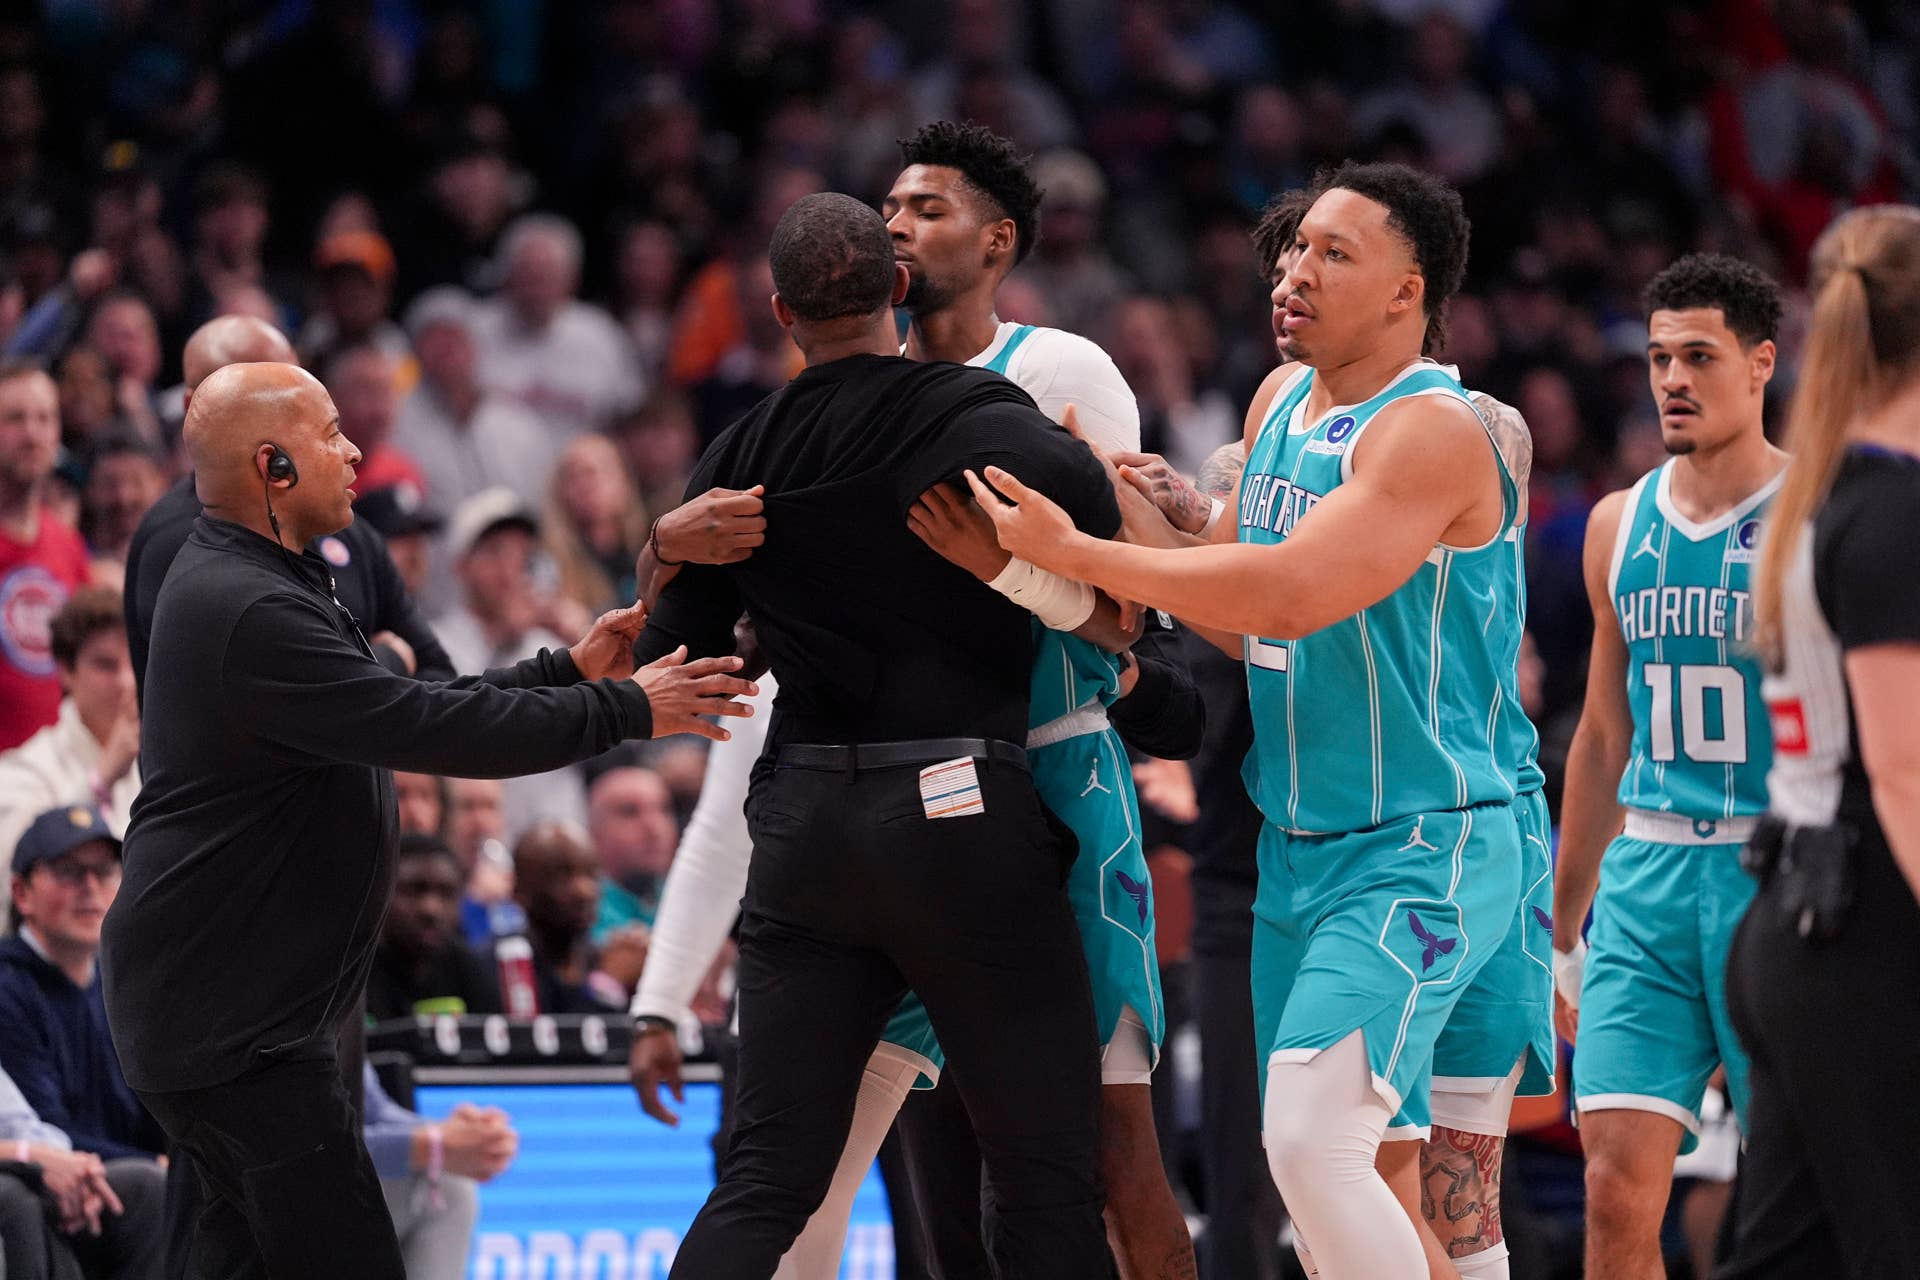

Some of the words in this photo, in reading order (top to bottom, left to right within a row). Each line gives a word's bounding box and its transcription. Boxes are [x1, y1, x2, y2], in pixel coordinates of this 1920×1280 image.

[1240, 473, 1323, 538] HORNET
[1618, 585, 1750, 644] HORNET
[1643, 662, 1748, 764] 10
